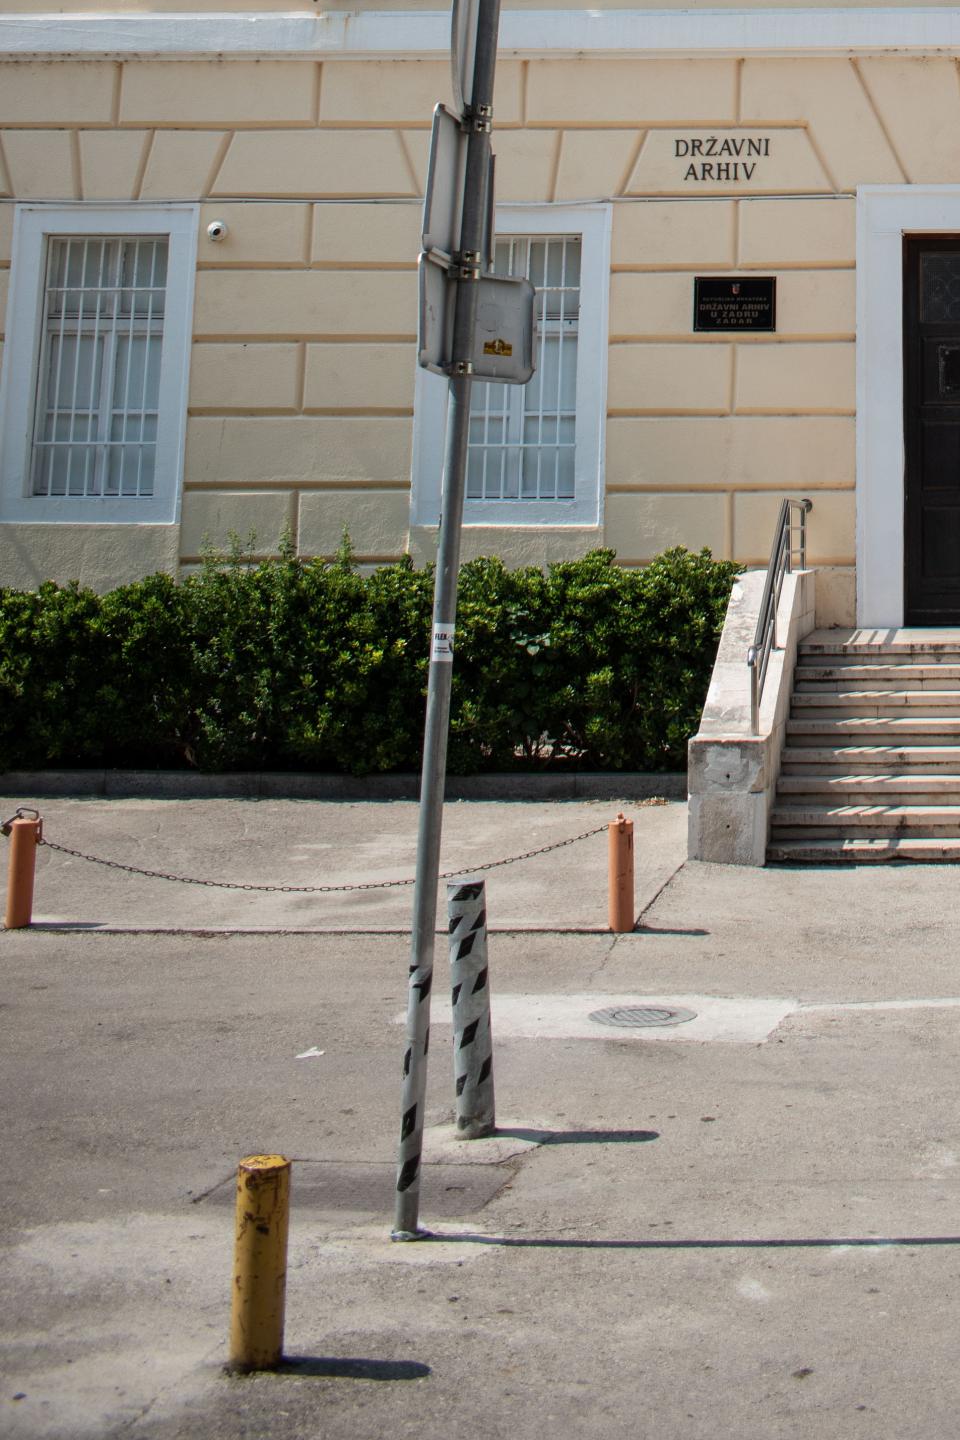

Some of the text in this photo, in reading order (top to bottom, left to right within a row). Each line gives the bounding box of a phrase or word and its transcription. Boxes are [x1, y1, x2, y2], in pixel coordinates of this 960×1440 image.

[675, 136, 770, 157] DRŽAVNI
[683, 163, 757, 181] ARHIV
[699, 302, 739, 310] DRŽAVNI
